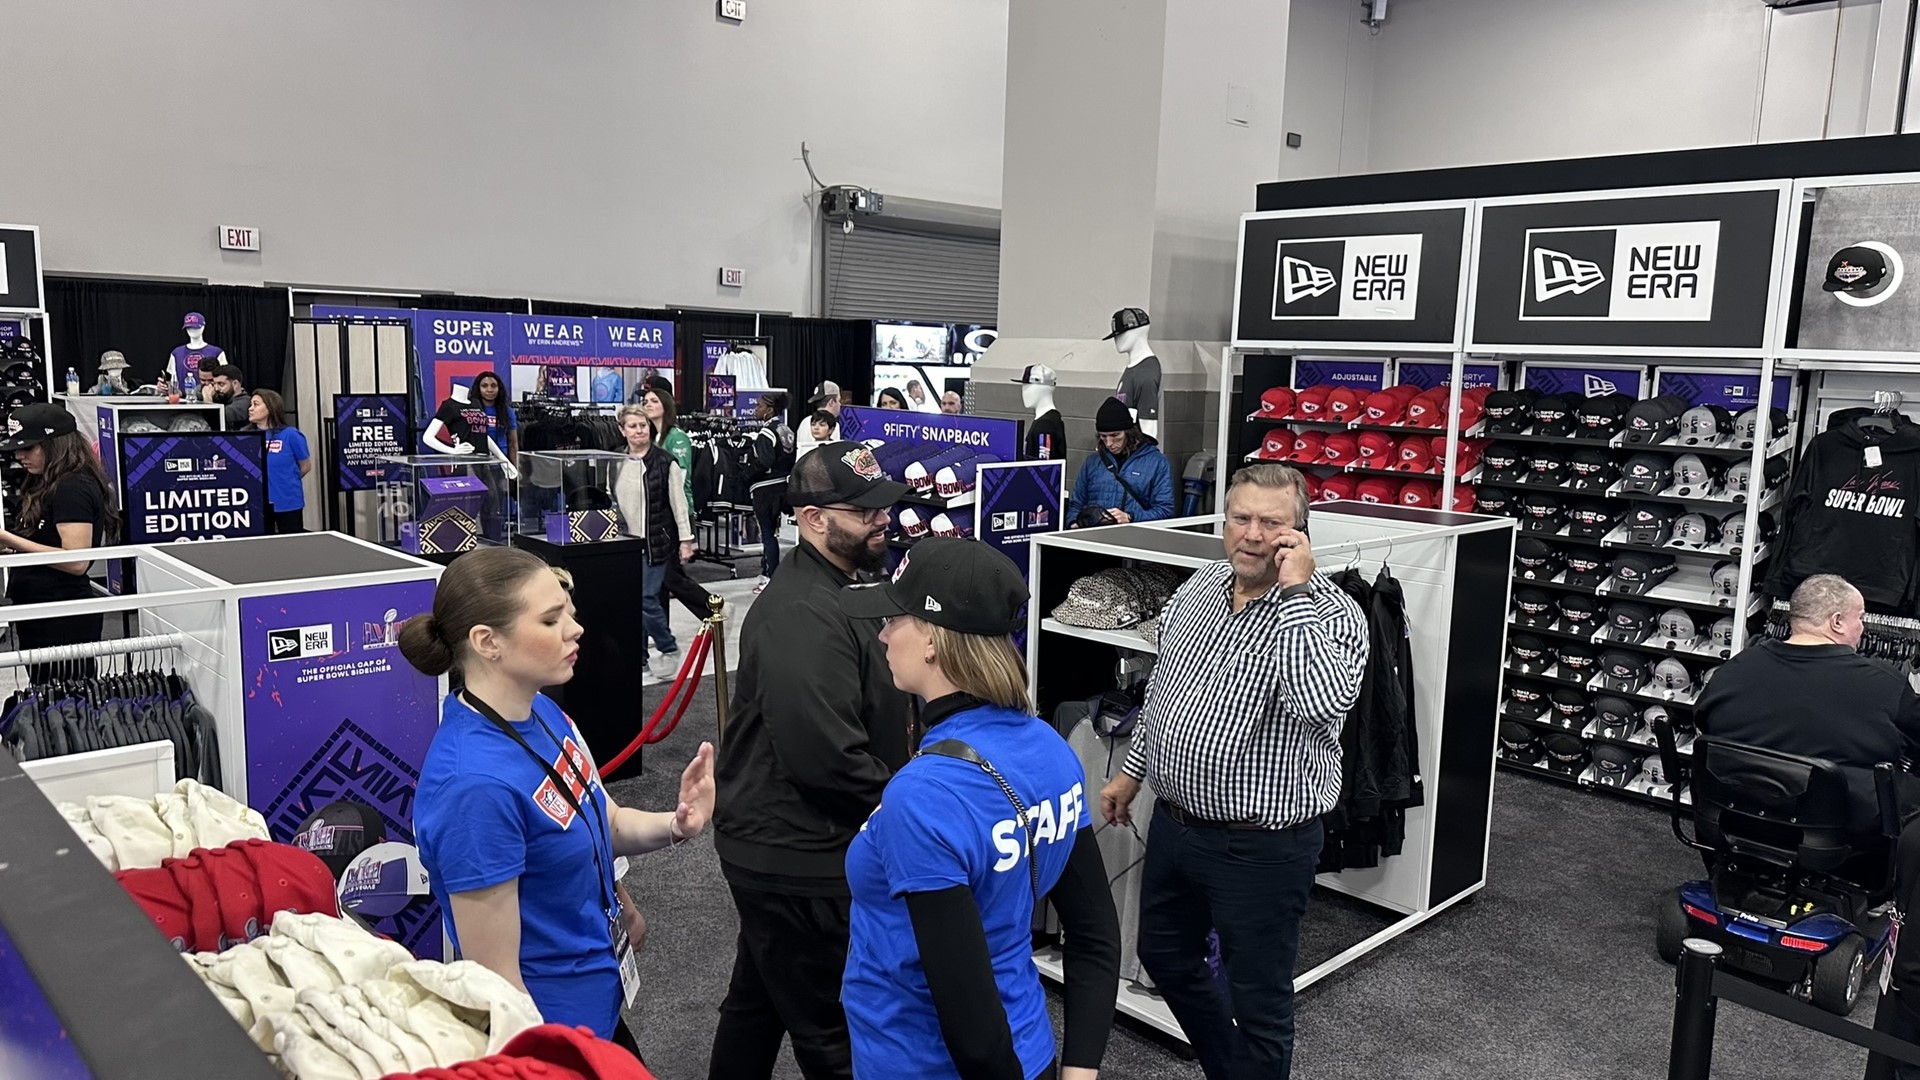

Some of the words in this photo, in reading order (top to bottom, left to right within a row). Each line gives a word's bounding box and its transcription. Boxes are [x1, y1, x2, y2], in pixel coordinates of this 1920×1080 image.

[227, 228, 251, 247] EXIT
[1354, 254, 1408, 277] NEW
[1629, 244, 1701, 272] NEW
[1352, 279, 1406, 301] ERA
[1627, 273, 1698, 299] ERA
[433, 319, 494, 337] SUPER
[523, 322, 583, 340] WEAR
[608, 325, 662, 343] WEAR
[435, 338, 494, 355] BOWL
[1331, 373, 1377, 382] ADJUSTABLE
[467, 417, 486, 425] BOW
[352, 425, 394, 441] FREE
[922, 426, 990, 447] SNAPBACK
[145, 488, 249, 510] LIMITED
[1824, 488, 1867, 512] SUPER
[1865, 494, 1905, 518] BOWL
[145, 510, 250, 534] EDITION
[305, 631, 328, 642] NEW
[305, 639, 328, 651] ERA
[297, 674, 324, 683] SUPER
[325, 671, 349, 680] BOWL
[350, 664, 391, 676] SIDELINES
[302, 668, 318, 676] THE
[319, 662, 355, 673] OFFICIAL
[357, 660, 374, 668] CAP
[992, 781, 1083, 872] STAFF
